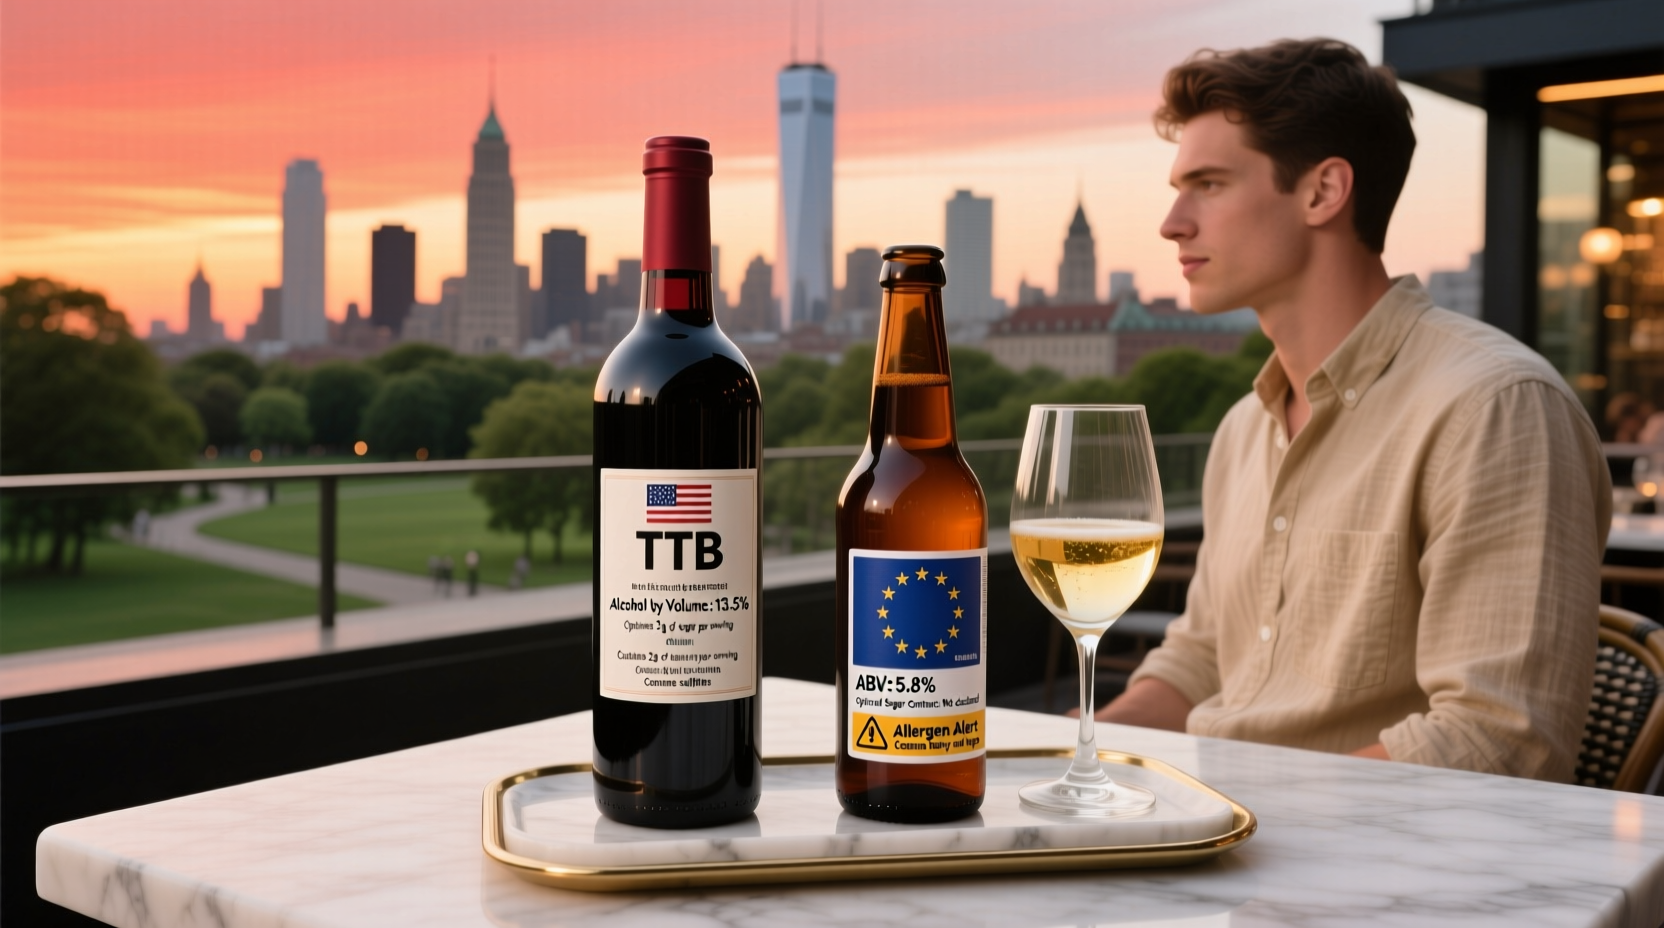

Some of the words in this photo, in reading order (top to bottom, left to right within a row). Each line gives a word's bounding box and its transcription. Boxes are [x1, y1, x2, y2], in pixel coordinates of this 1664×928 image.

[636, 531, 723, 570] TTB
[609, 597, 647, 611] Alcohol
[715, 596, 749, 611] 13.5%
[855, 674, 893, 692] ABV:
[896, 676, 936, 693] 5.8%
[893, 724, 950, 741] Allergen
[953, 720, 978, 736] Alert
